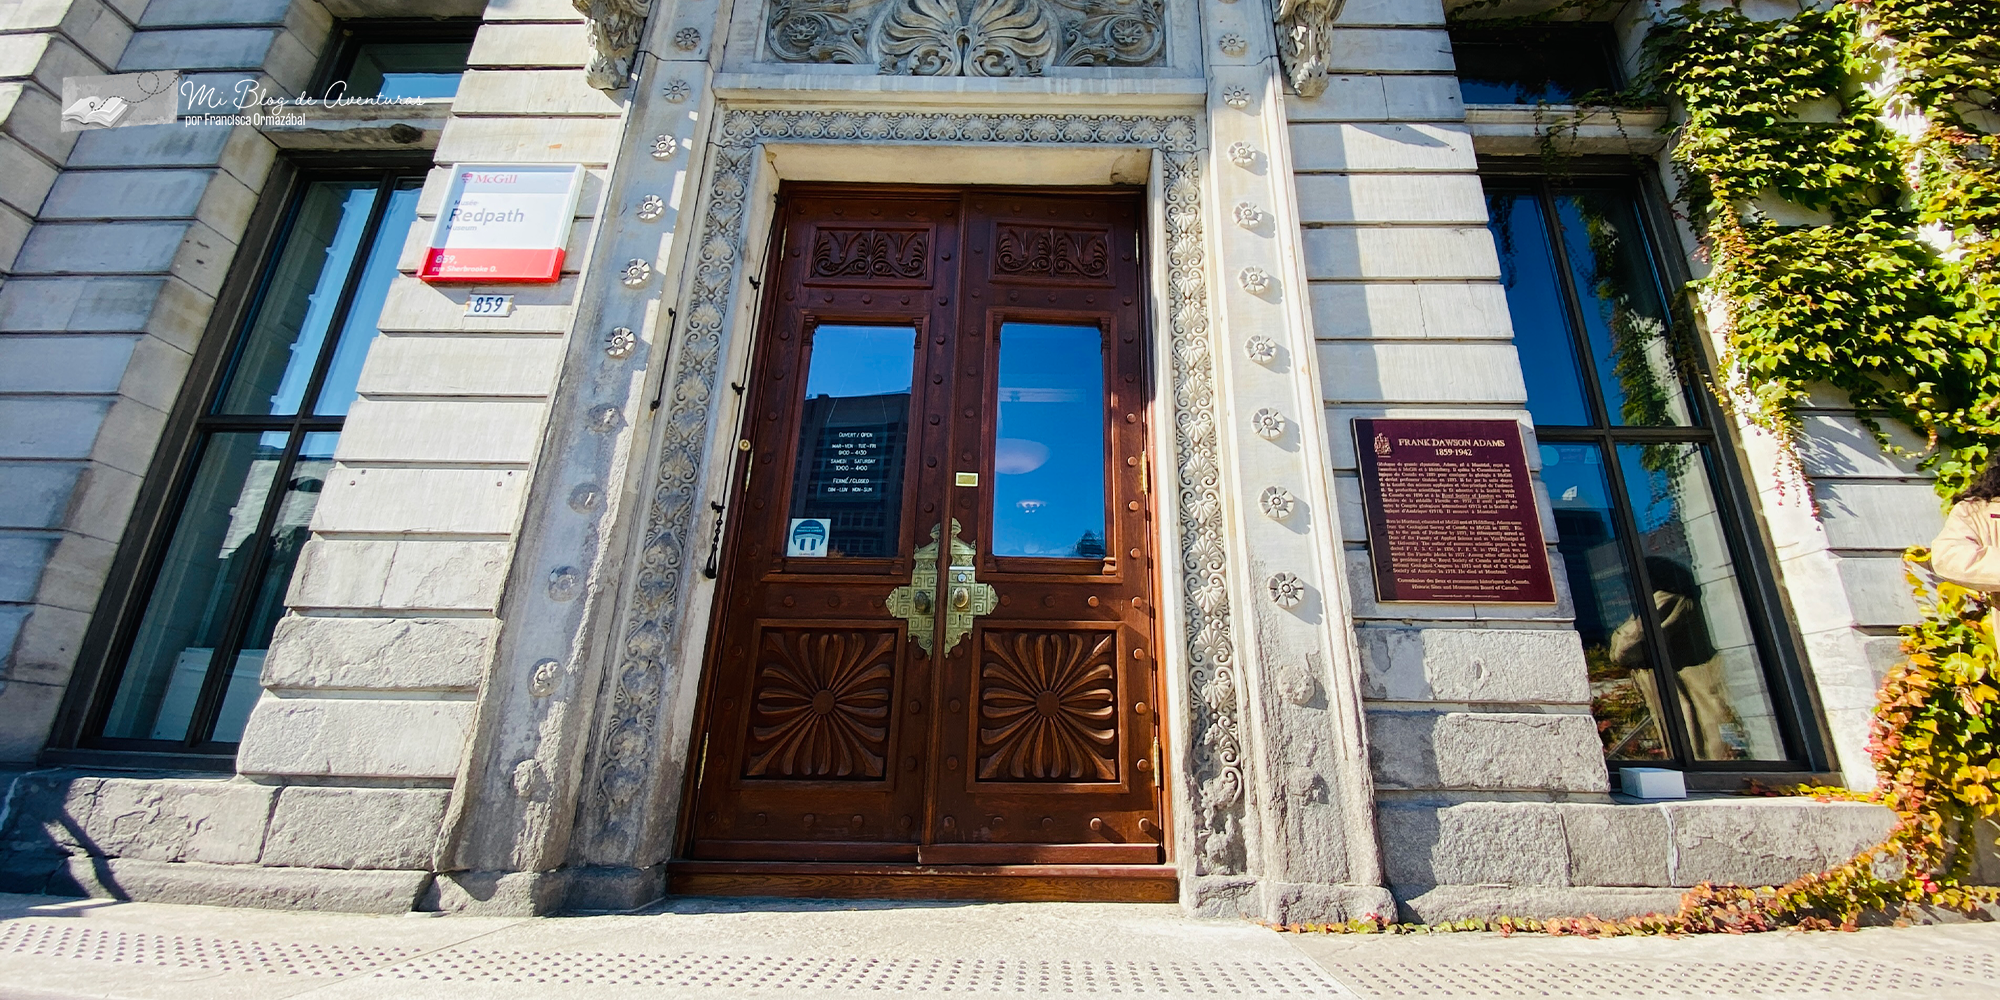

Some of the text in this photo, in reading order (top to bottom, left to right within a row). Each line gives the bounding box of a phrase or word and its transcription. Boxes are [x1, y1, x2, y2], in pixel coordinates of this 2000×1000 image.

[474, 174, 518, 184] McGill
[449, 208, 524, 225] Redpath
[474, 297, 503, 313] 859
